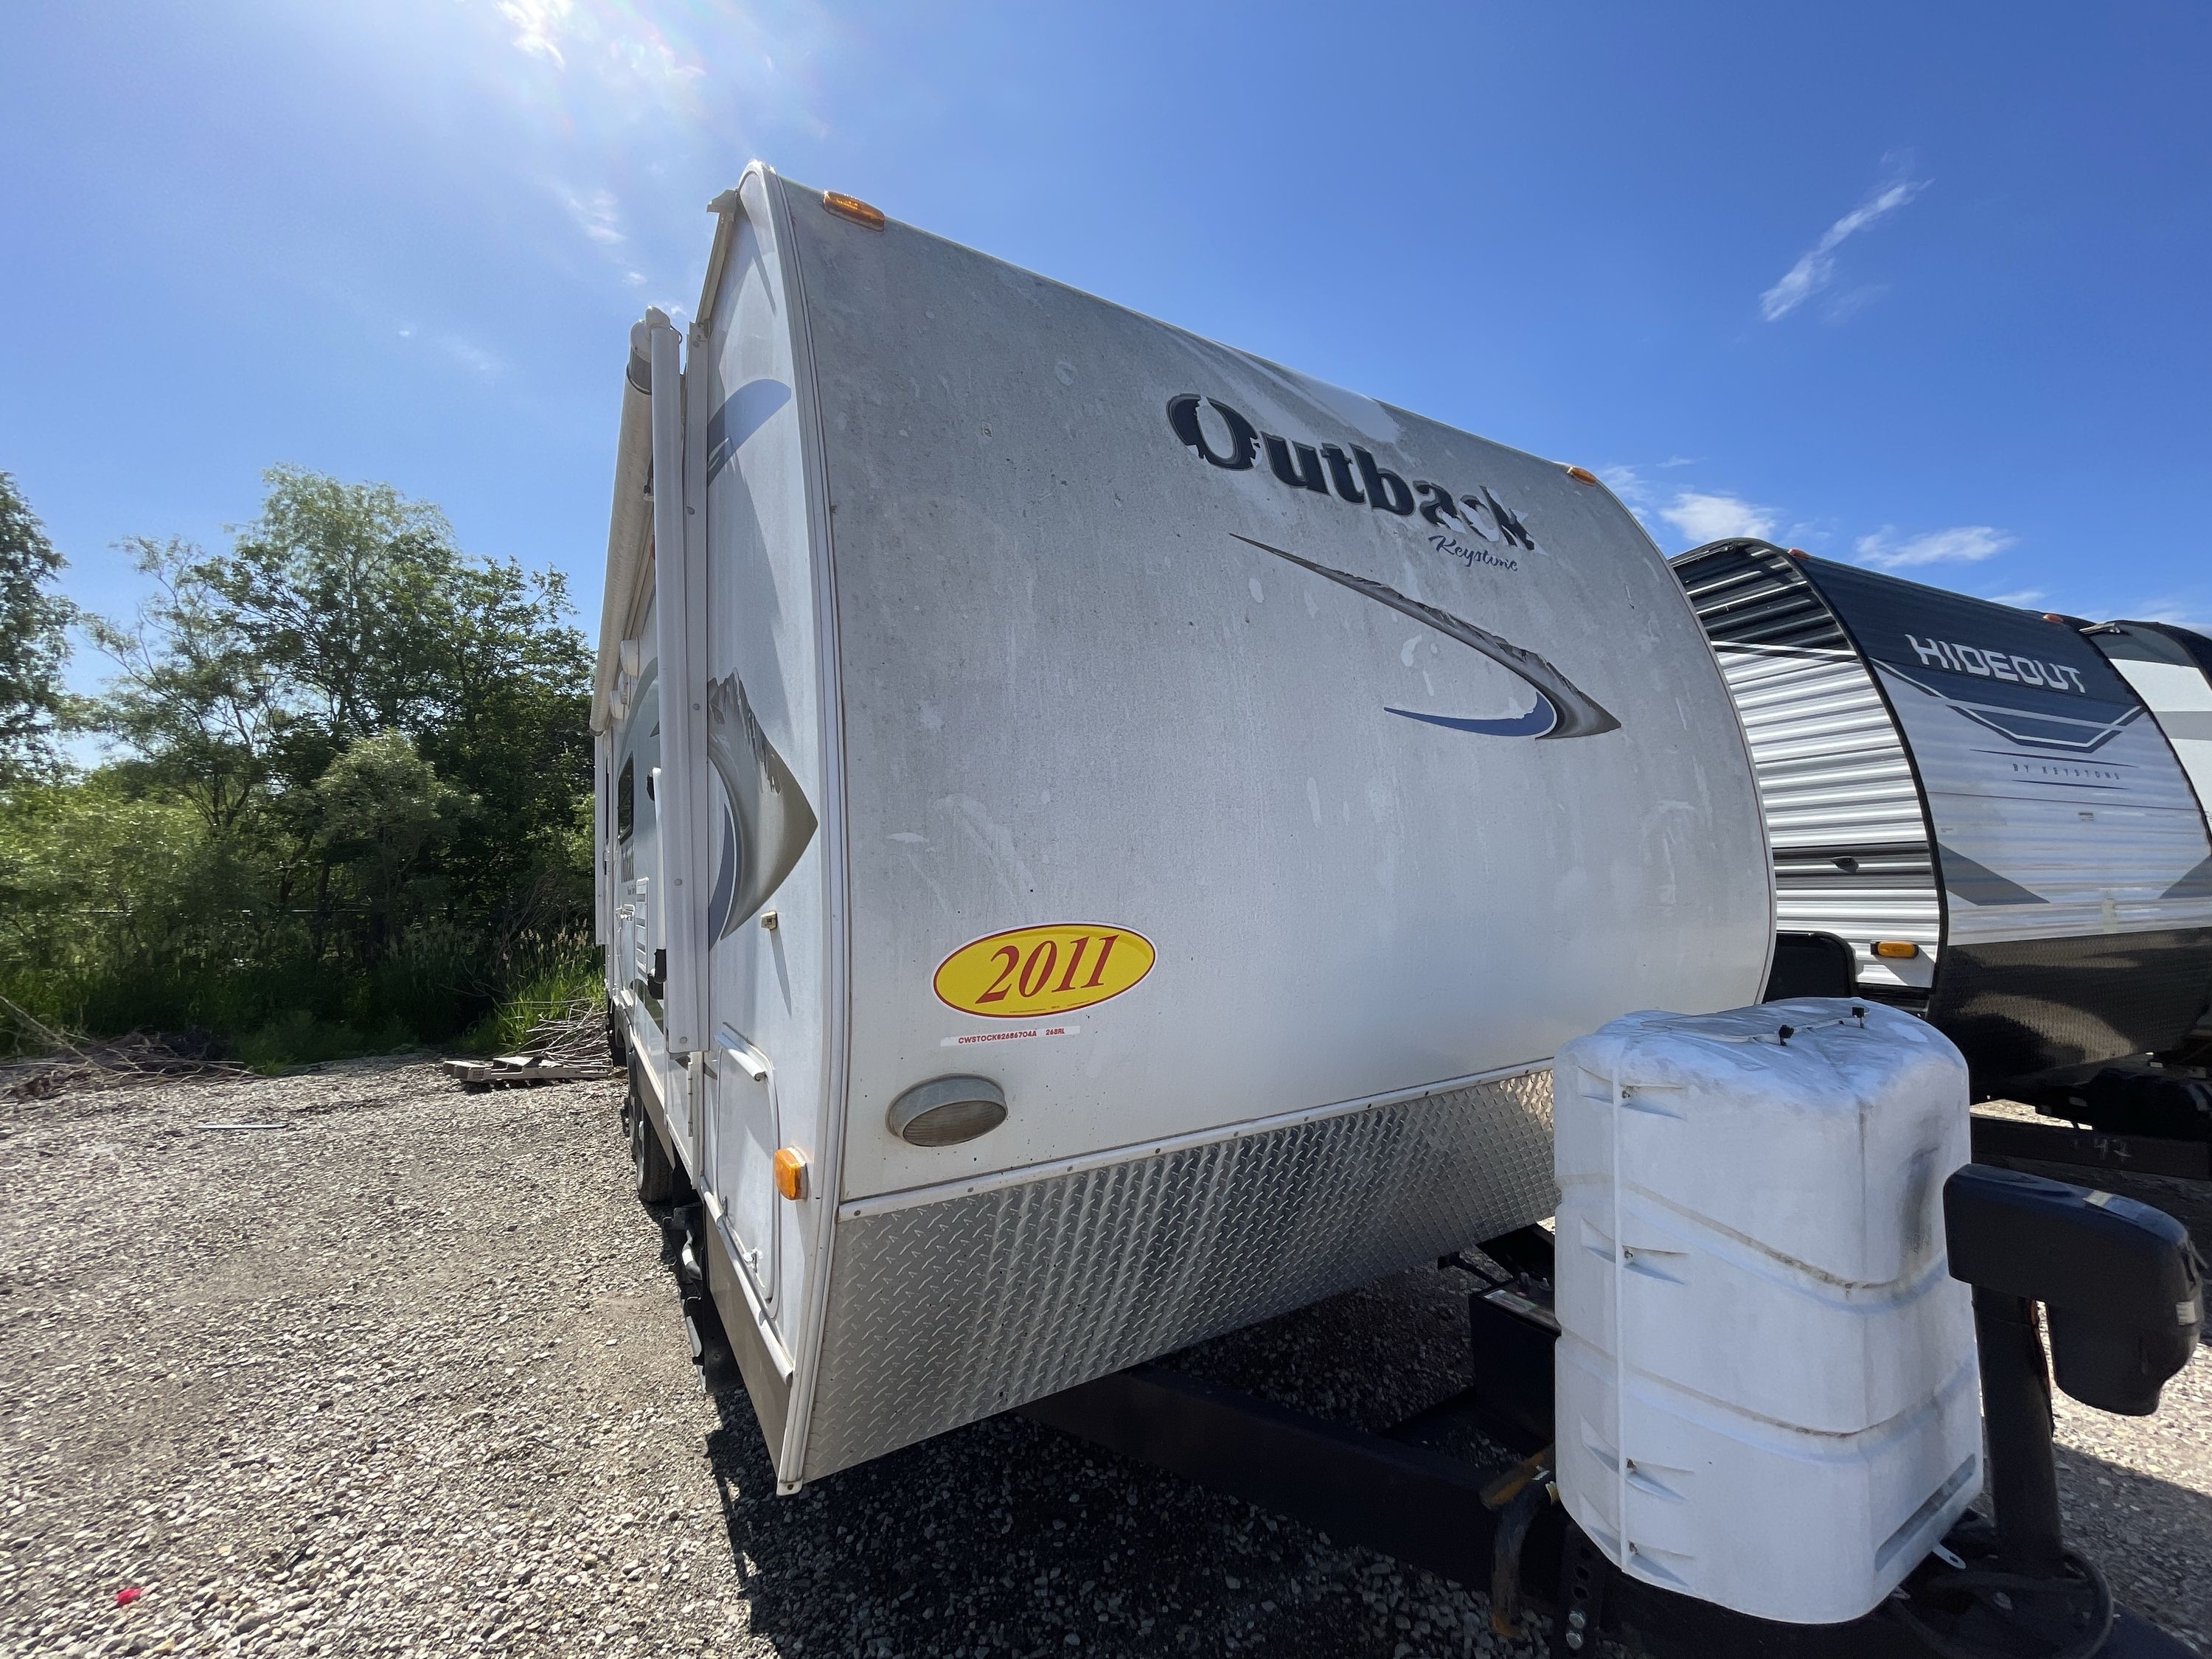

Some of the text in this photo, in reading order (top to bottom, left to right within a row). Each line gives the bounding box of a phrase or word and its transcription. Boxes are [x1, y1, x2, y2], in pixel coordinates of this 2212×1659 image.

[1166, 392, 1541, 553] Outback
[1427, 535, 1518, 572] Keystone
[1905, 633, 2087, 694] HIDEOUT
[2012, 763, 2121, 780] BY KEYSTONE
[974, 933, 1120, 1005] 2011
[1045, 1028, 1065, 1036] 268RL
